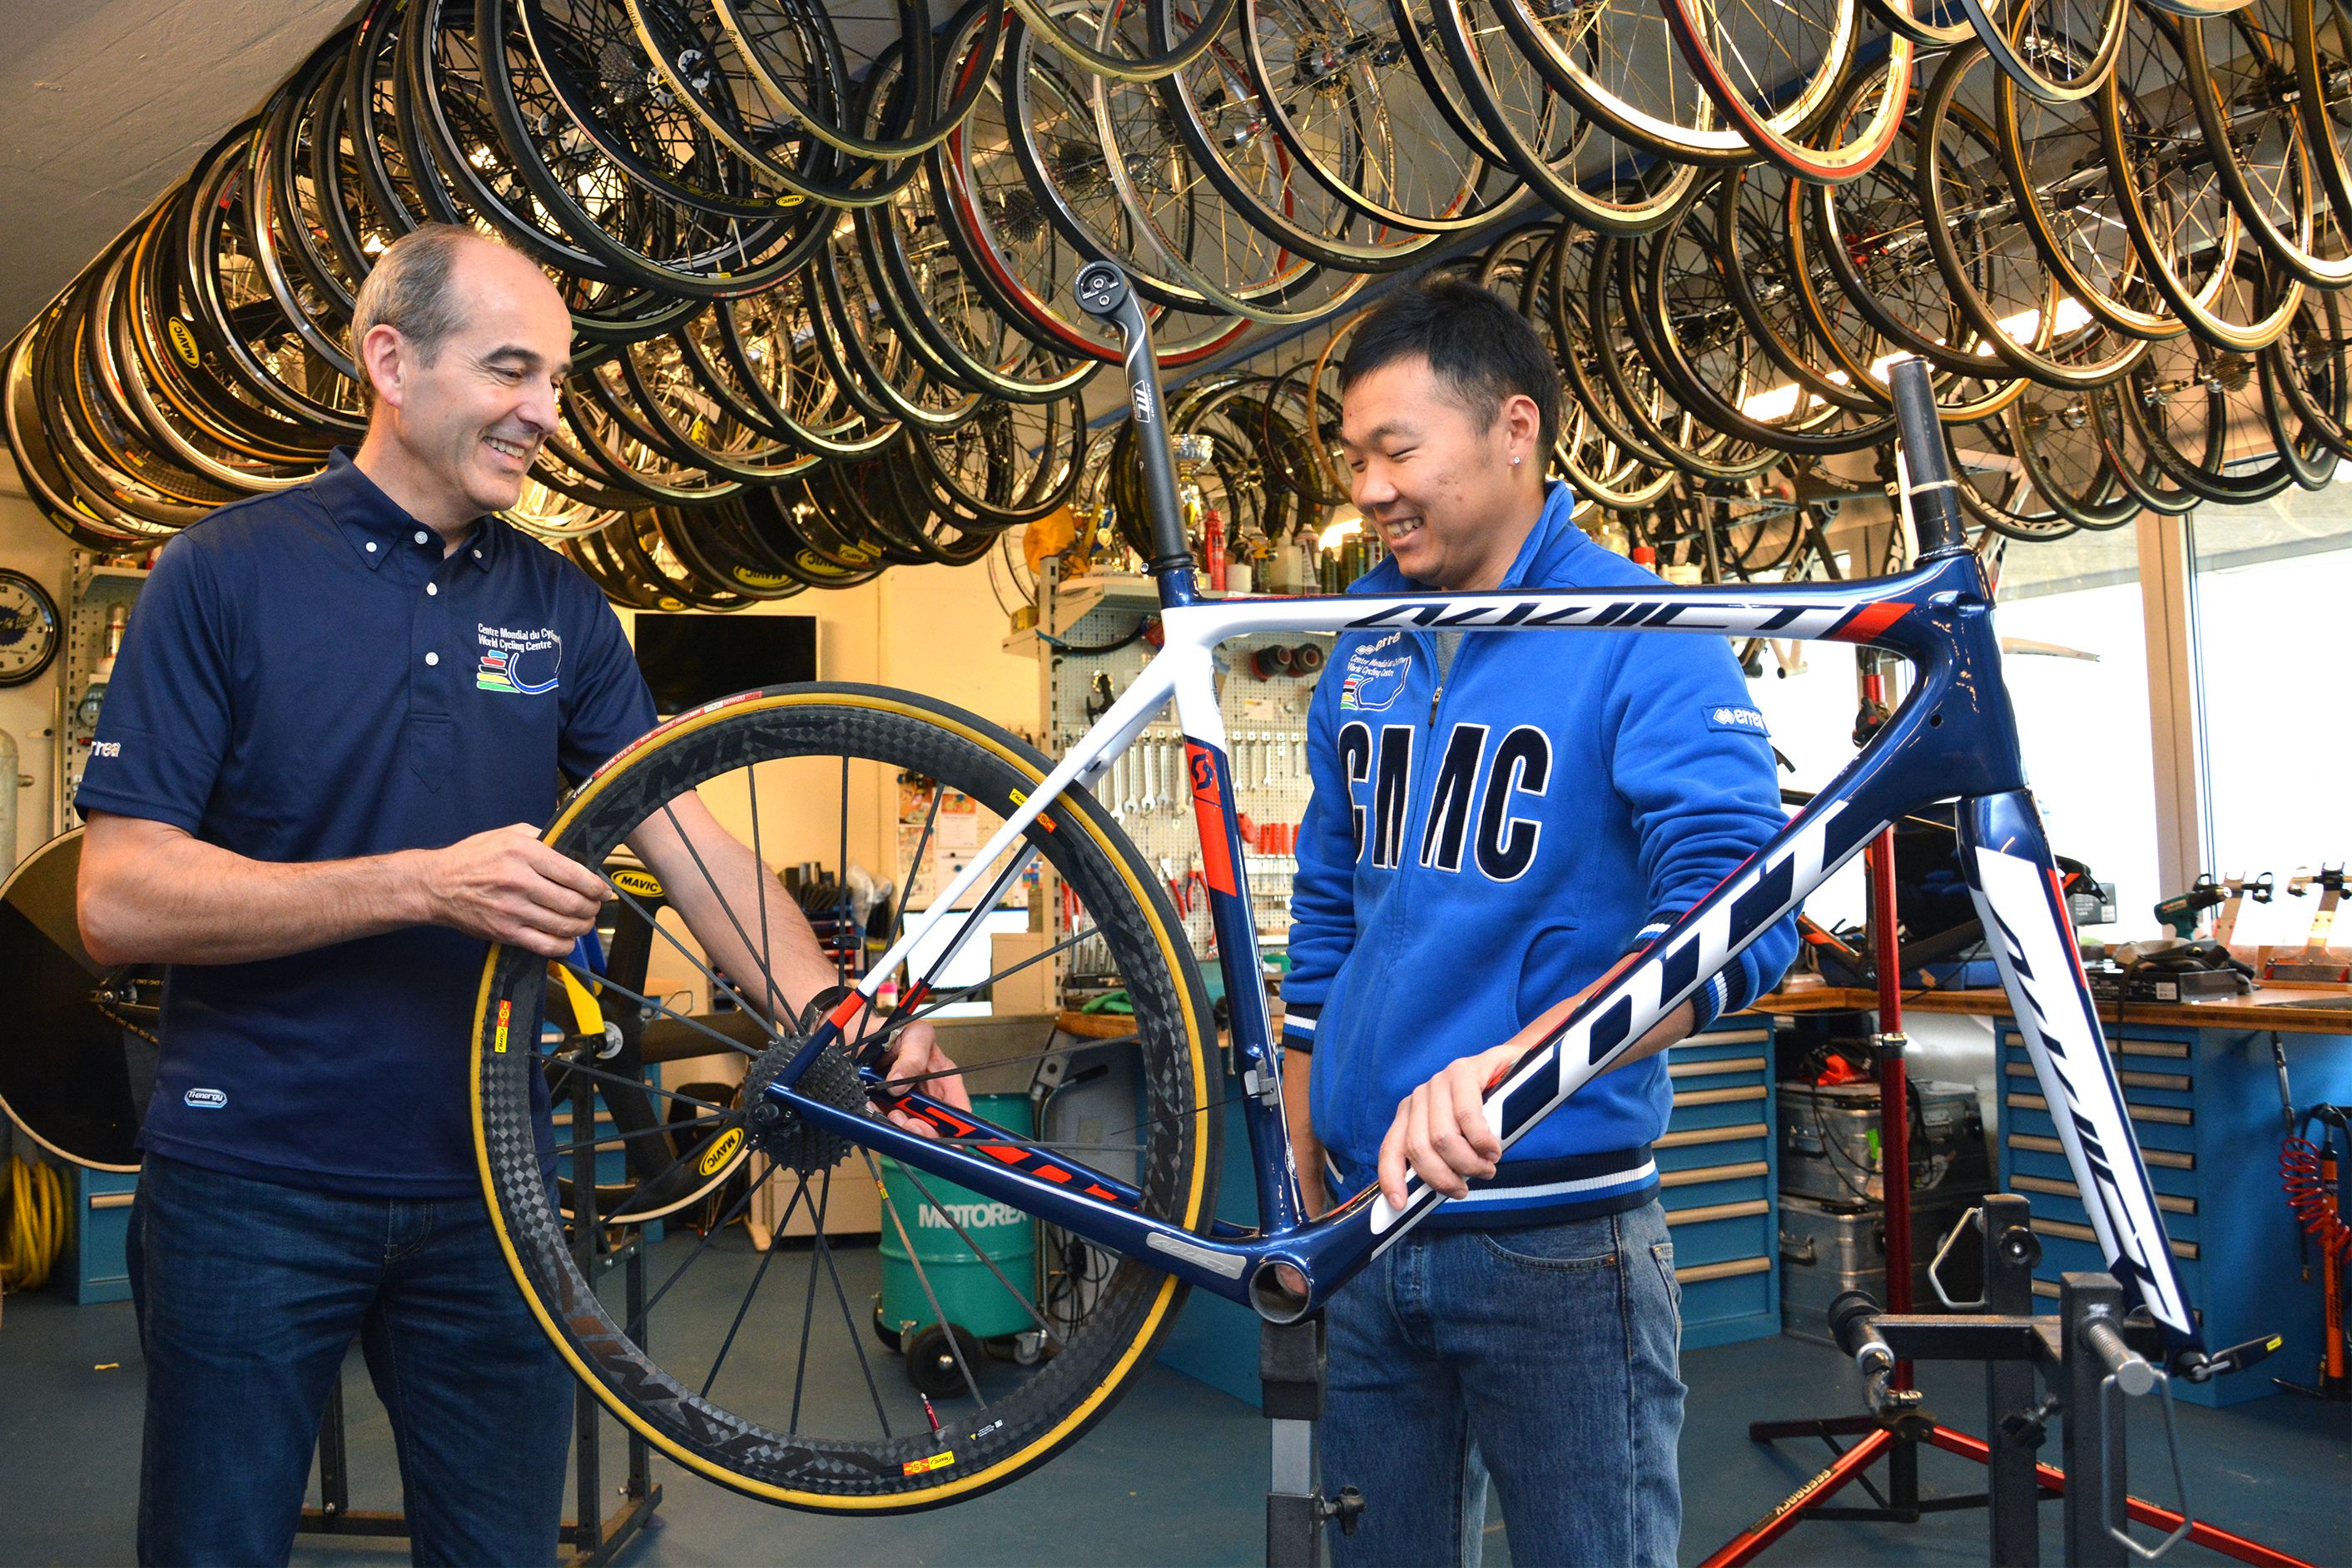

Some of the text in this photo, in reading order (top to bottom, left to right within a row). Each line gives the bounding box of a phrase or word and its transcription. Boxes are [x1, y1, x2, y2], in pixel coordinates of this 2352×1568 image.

[782, 196, 800, 205] MAVIC
[174, 325, 196, 359] MAVIC
[478, 623, 499, 637] Centre
[500, 628, 528, 640] Mondial
[529, 630, 540, 640] du
[478, 633, 552, 653] World Cycling Centre
[621, 875, 658, 892] MAVIC
[188, 1091, 223, 1101] Ti-energy
[707, 1134, 736, 1168] MAVIC
